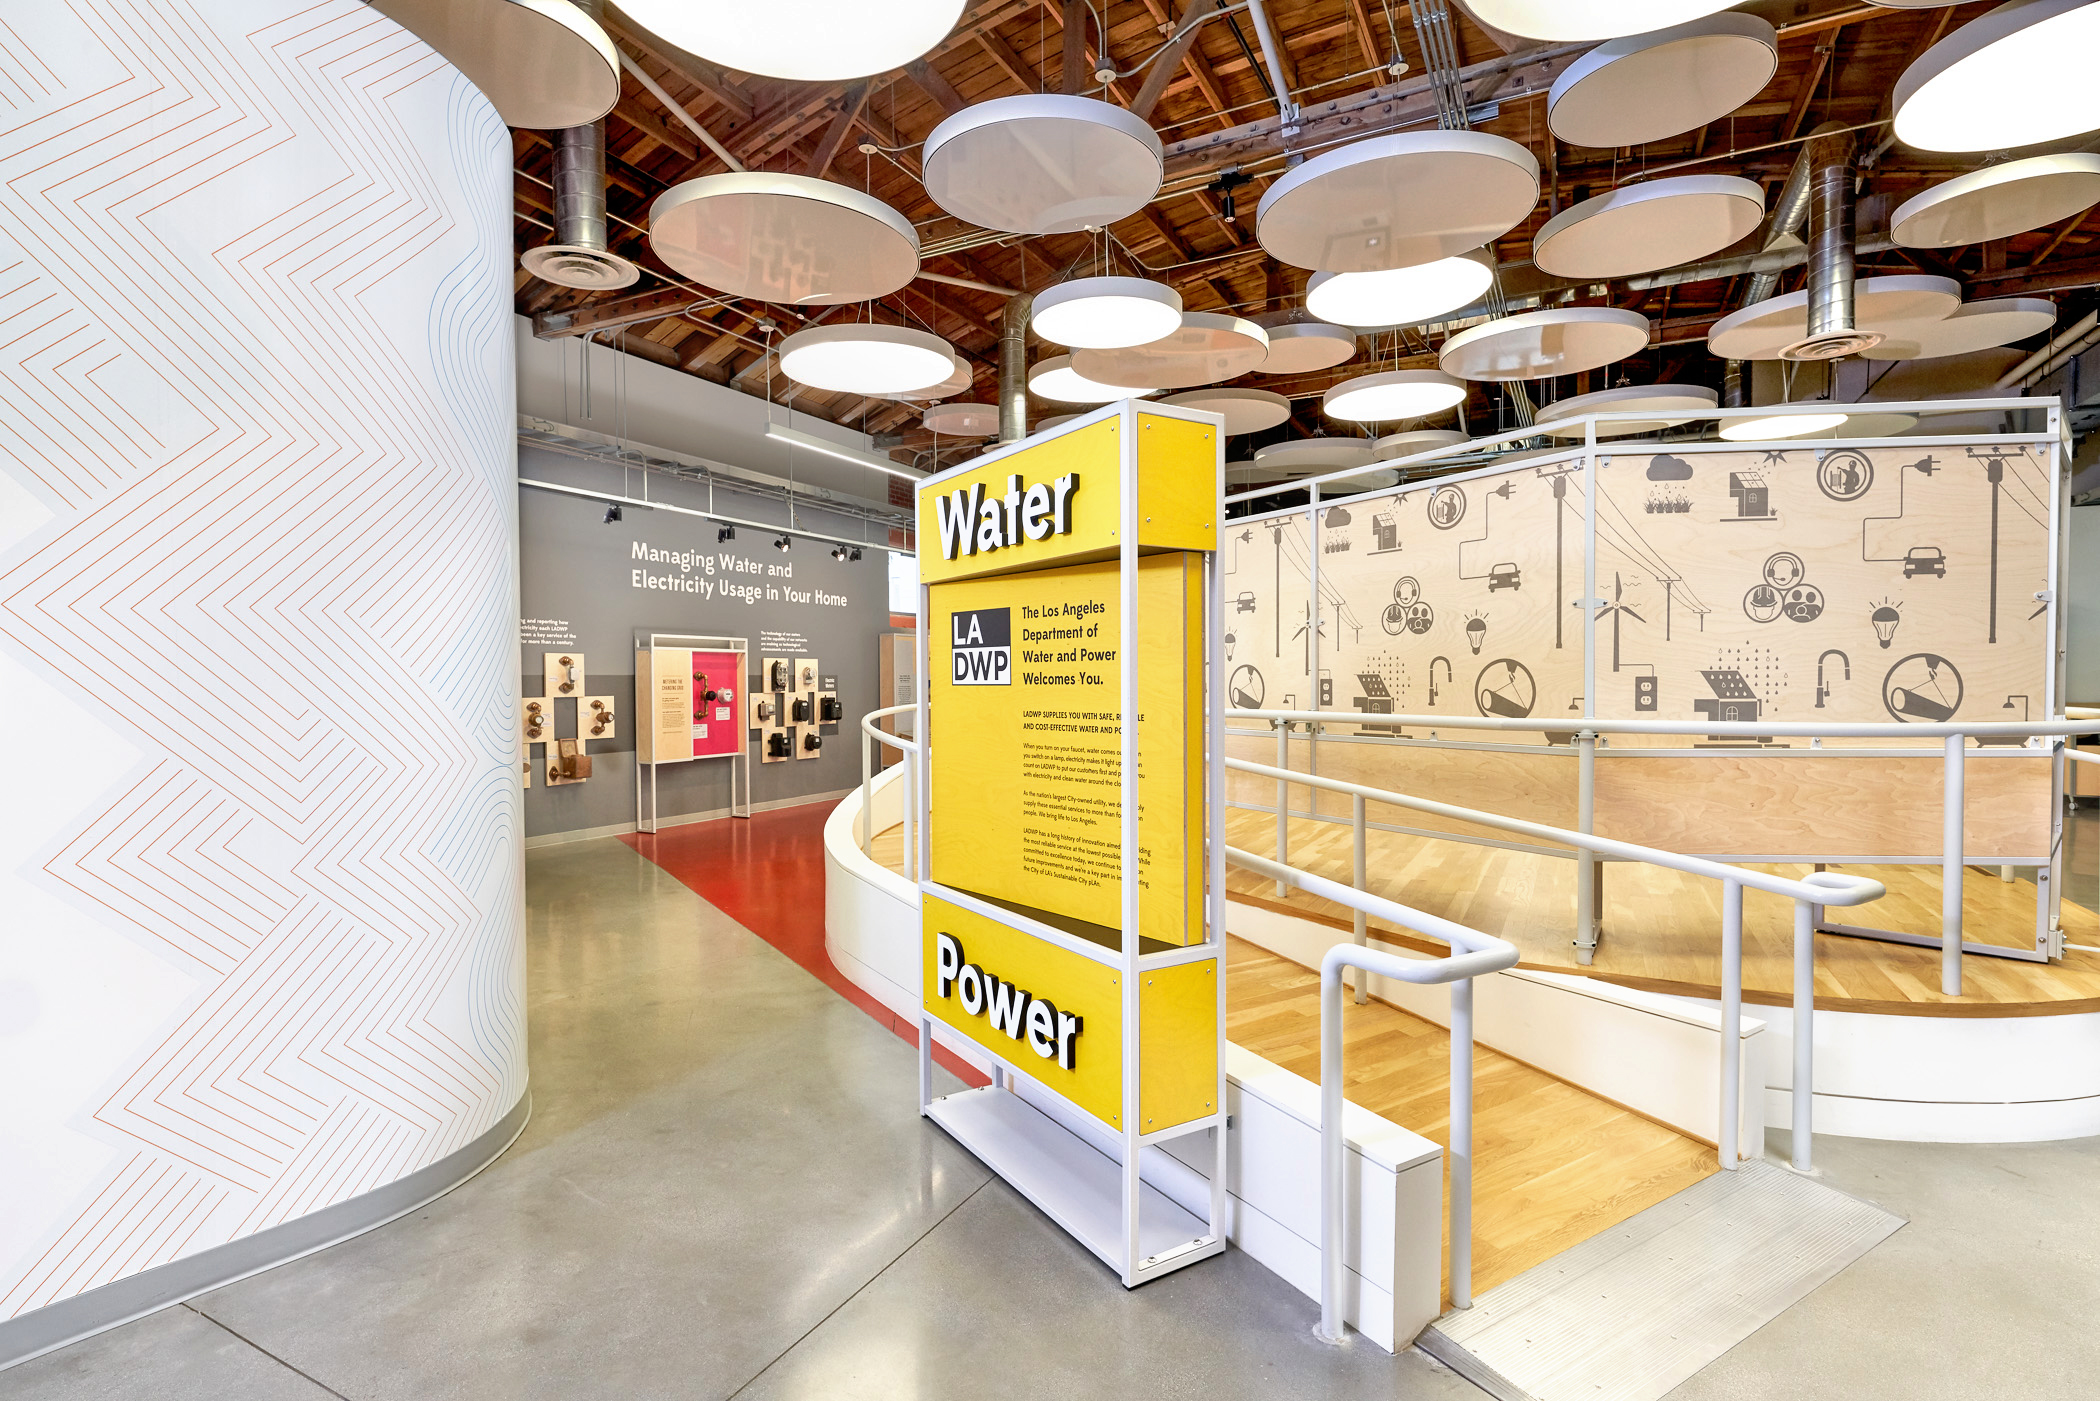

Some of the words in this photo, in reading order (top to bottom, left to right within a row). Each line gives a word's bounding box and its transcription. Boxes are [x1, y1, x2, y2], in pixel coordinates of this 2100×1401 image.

[936, 473, 1080, 560] Water
[632, 541, 714, 575] Managing
[719, 553, 763, 575] Water
[768, 562, 792, 578] and
[632, 569, 714, 600] Electricity
[719, 579, 761, 604] Usage
[766, 584, 778, 601] in
[783, 586, 811, 604] Your
[815, 590, 847, 607] Home
[1022, 606, 1039, 619] The
[1042, 604, 1059, 617] Los
[1062, 600, 1105, 620] Angeles
[953, 614, 983, 646] LA
[1023, 625, 1083, 644] Department
[1086, 623, 1098, 638] of
[1023, 650, 1053, 663] Water
[1057, 649, 1077, 662] and
[1081, 649, 1116, 662] Power
[955, 651, 1008, 681] DWP
[1023, 672, 1076, 685] Welcomes
[1079, 672, 1104, 685] You.
[1099, 713, 1114, 721] SAFE,
[1035, 723, 1077, 731] COST-EFFECTIVE
[1066, 756, 1085, 764] electricity
[1105, 759, 1114, 767] light
[1077, 766, 1098, 774] customers
[1033, 772, 1052, 781] electricity
[1023, 799, 1036, 808] supply
[1049, 802, 1067, 810] essential
[1068, 805, 1085, 813] services
[1053, 793, 1066, 802] largest
[1047, 812, 1057, 820] bring
[1023, 827, 1038, 835] LADWP
[1051, 832, 1060, 840] long
[1061, 833, 1075, 843] history
[1082, 837, 1105, 846] innovation
[1107, 841, 1121, 849] aimed
[1041, 840, 1056, 848] reliable
[1057, 843, 1072, 851] service
[1086, 848, 1101, 856] lowest
[1102, 851, 1121, 861] possible
[1050, 851, 1072, 861] excellence
[1095, 860, 1115, 869] continue
[1023, 855, 1035, 863] future
[1036, 858, 1064, 870] improvements
[1091, 868, 1099, 877] key
[1100, 870, 1109, 879] part
[1030, 866, 1039, 875] City
[1053, 871, 1077, 881] Sustainable
[1078, 876, 1087, 885] City
[937, 932, 1083, 1070] Power
